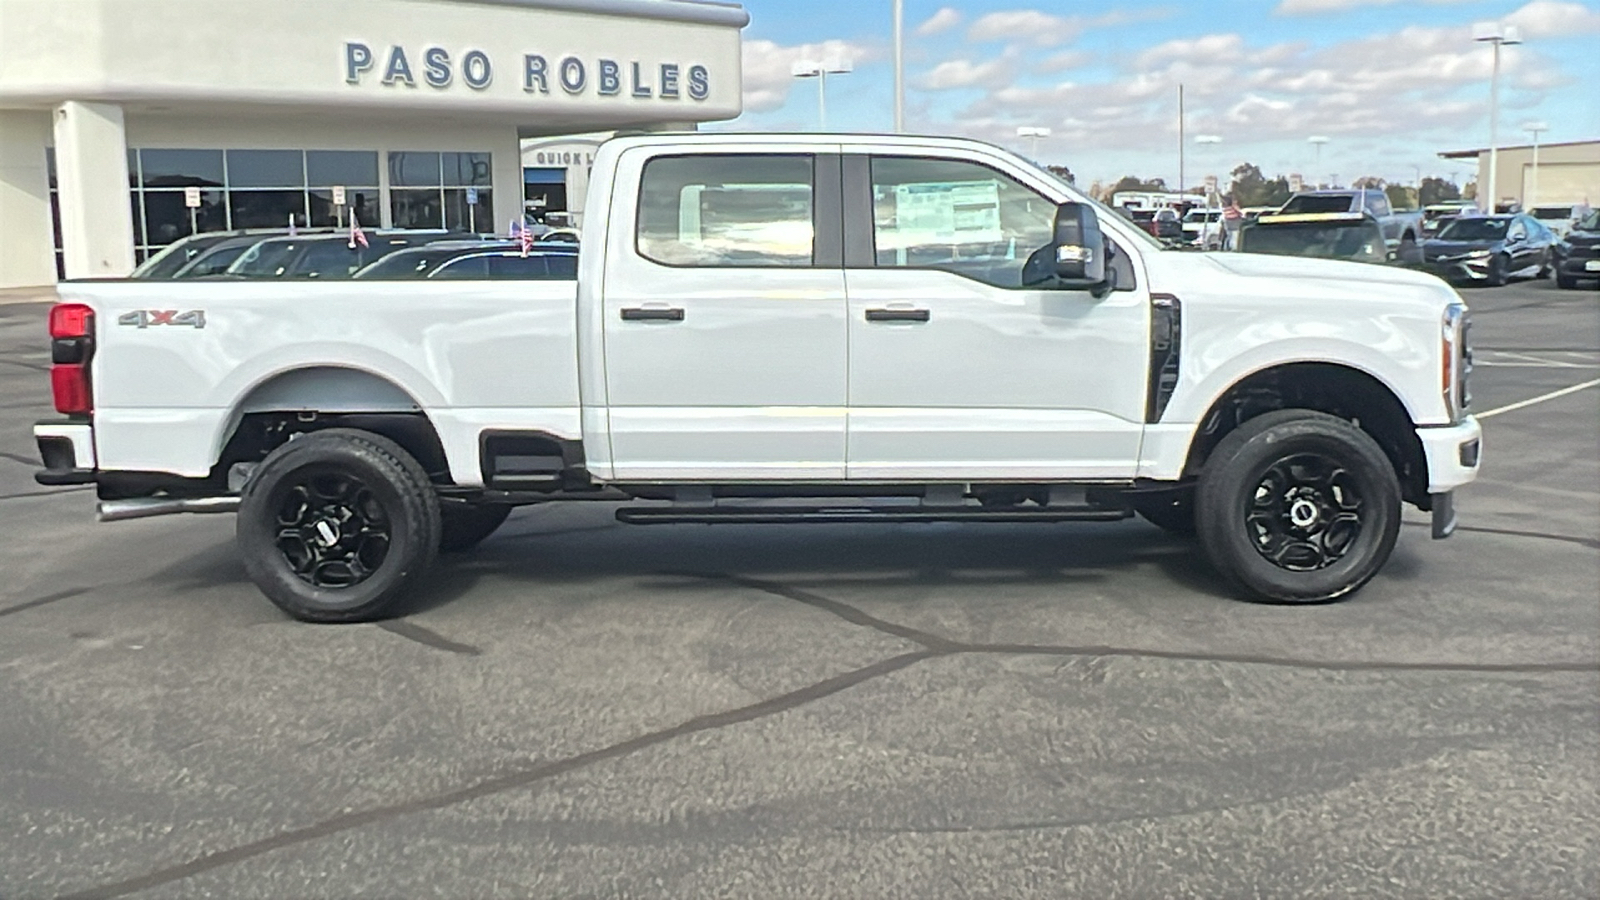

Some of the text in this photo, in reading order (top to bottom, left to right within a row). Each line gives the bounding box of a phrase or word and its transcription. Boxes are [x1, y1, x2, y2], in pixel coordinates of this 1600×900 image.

[345, 42, 710, 99] PASO ROBLES
[537, 152, 581, 165] QUICK
